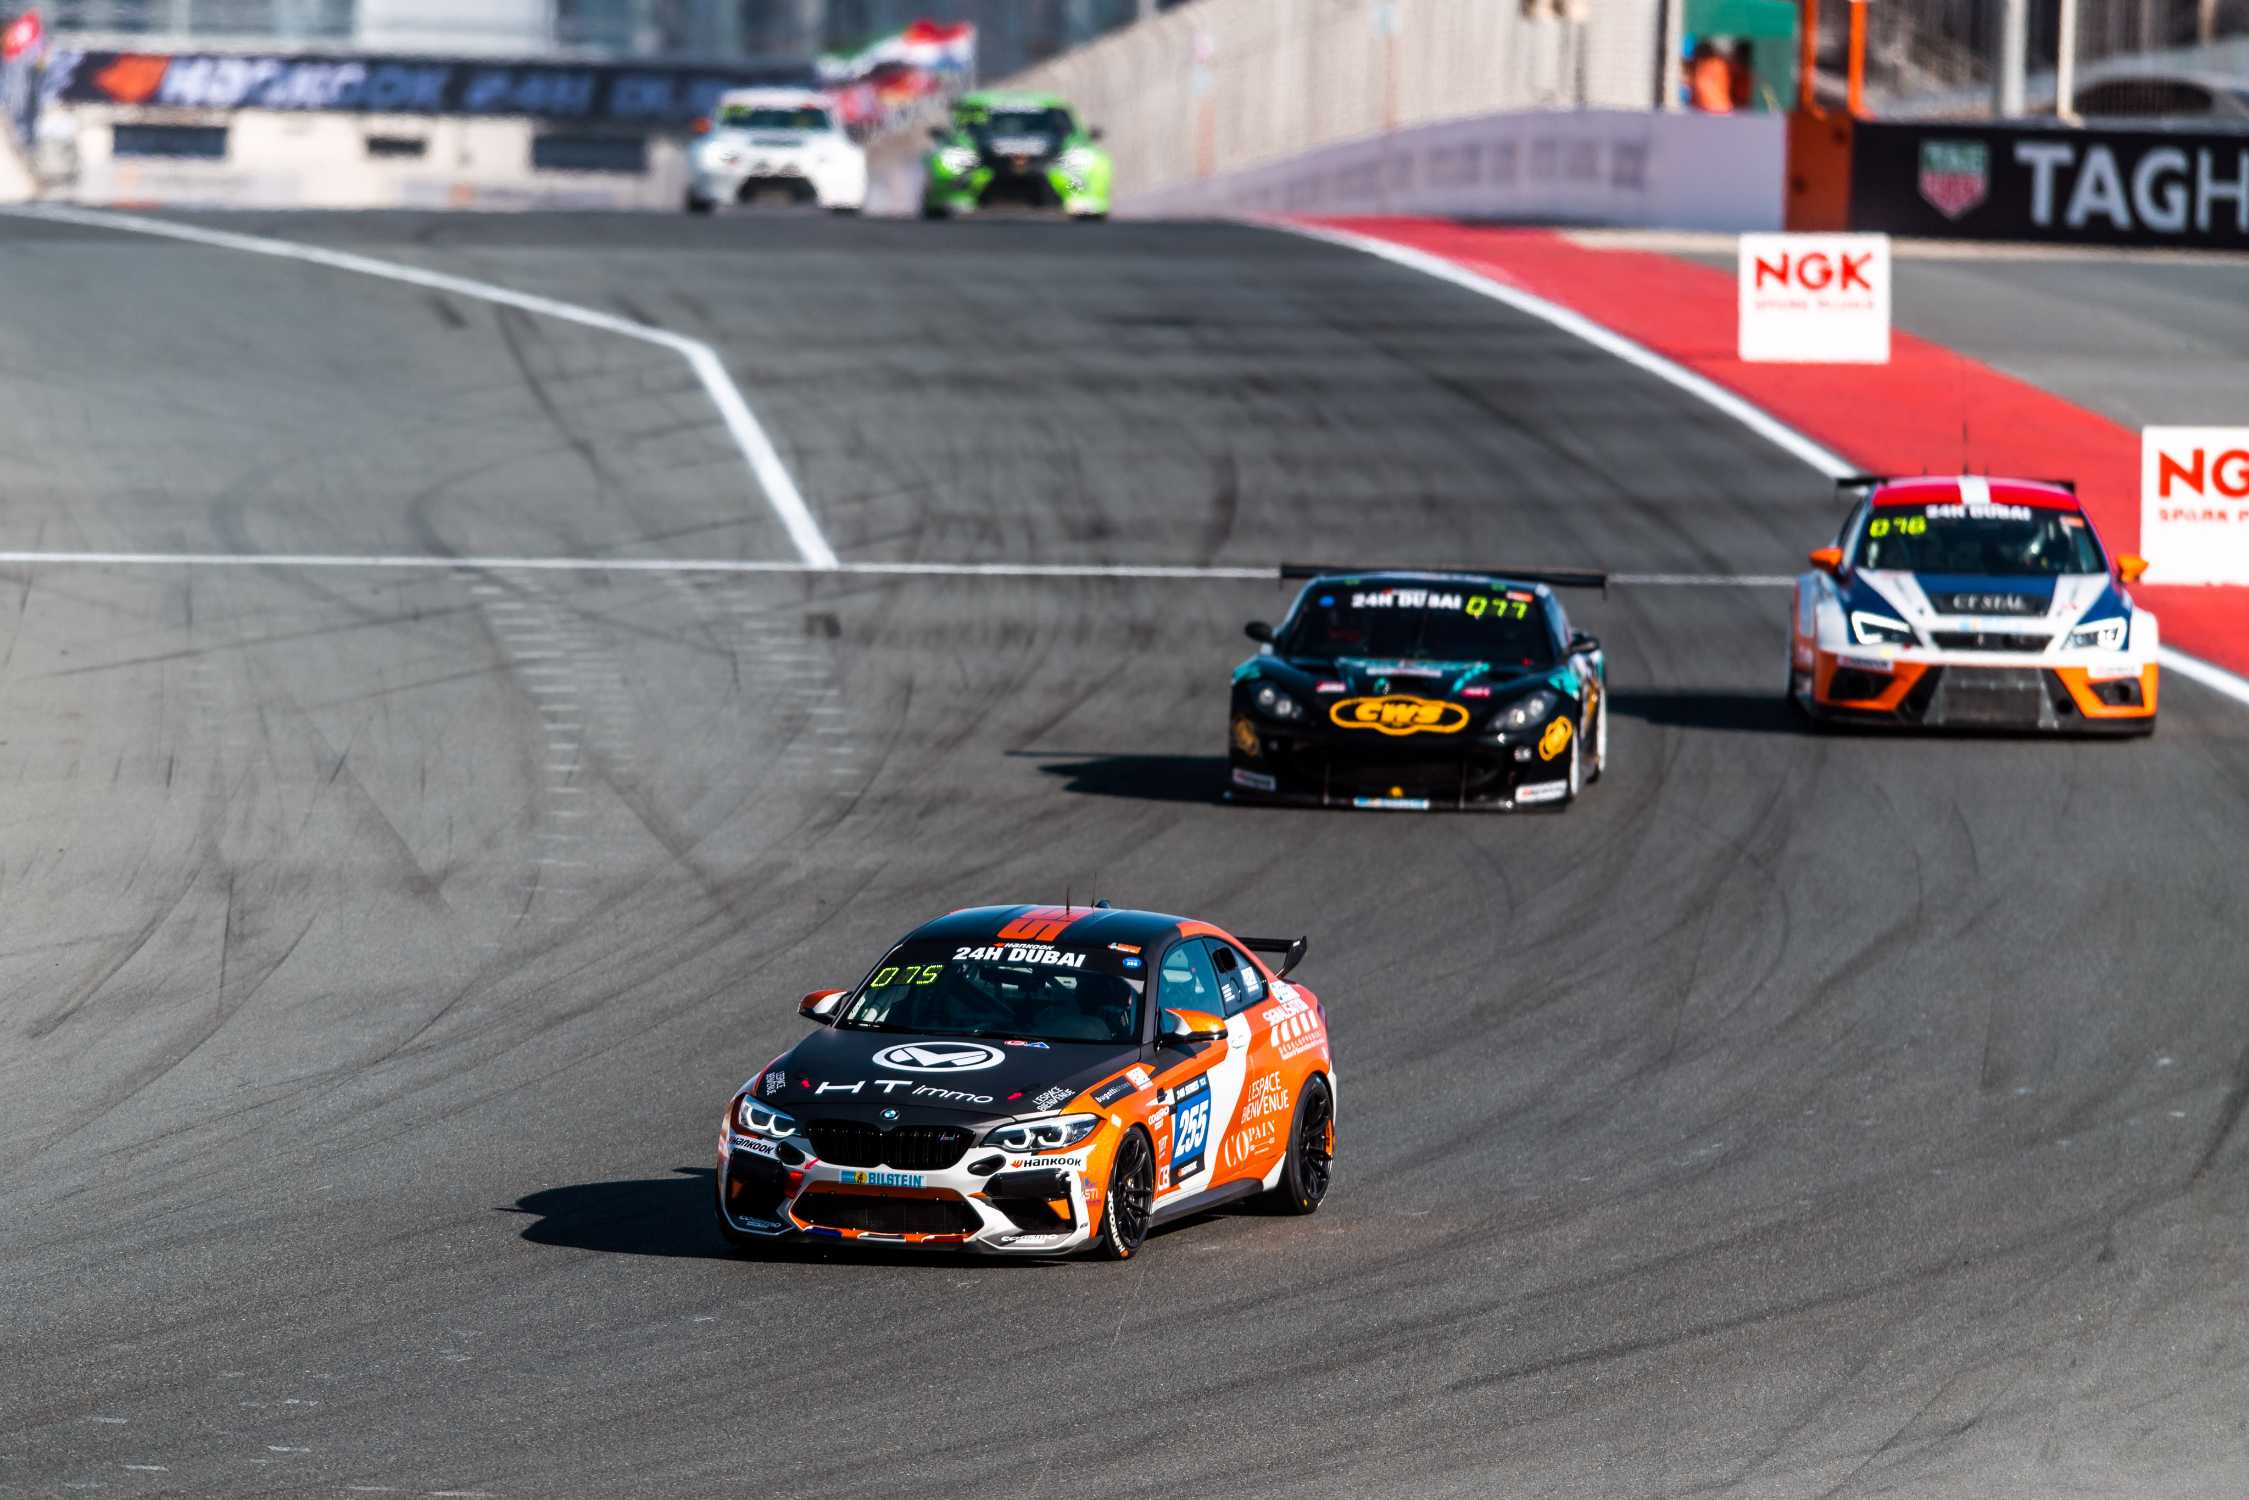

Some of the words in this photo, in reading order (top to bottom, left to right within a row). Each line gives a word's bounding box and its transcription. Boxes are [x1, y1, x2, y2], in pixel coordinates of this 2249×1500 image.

[1755, 253, 1872, 291] NGK
[1355, 702, 1444, 724] CWS
[953, 947, 1004, 961] 24H
[1007, 949, 1086, 968] DUBAI
[1174, 1099, 1209, 1159] 255
[868, 1172, 922, 1187] BILSTEIN
